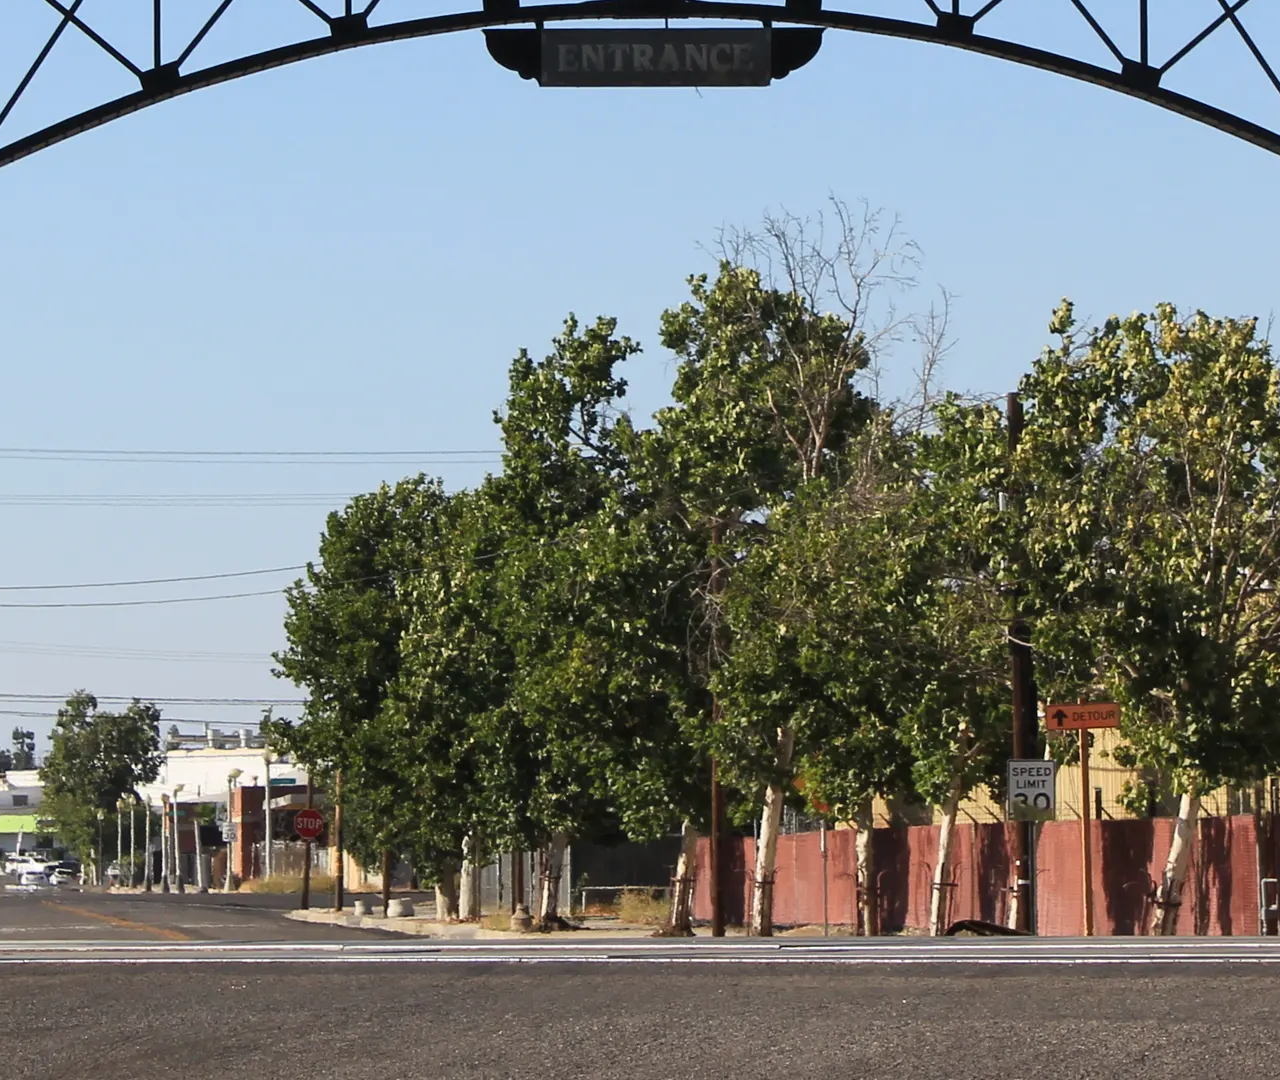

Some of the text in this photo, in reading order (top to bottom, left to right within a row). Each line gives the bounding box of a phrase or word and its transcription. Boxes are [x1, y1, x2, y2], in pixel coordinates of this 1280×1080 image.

[557, 43, 755, 72] ENTRANCE
[1072, 710, 1116, 722] DETOUR
[1012, 767, 1052, 777] SPEED
[1016, 780, 1047, 789] LIMIT
[296, 817, 322, 829] STOP
